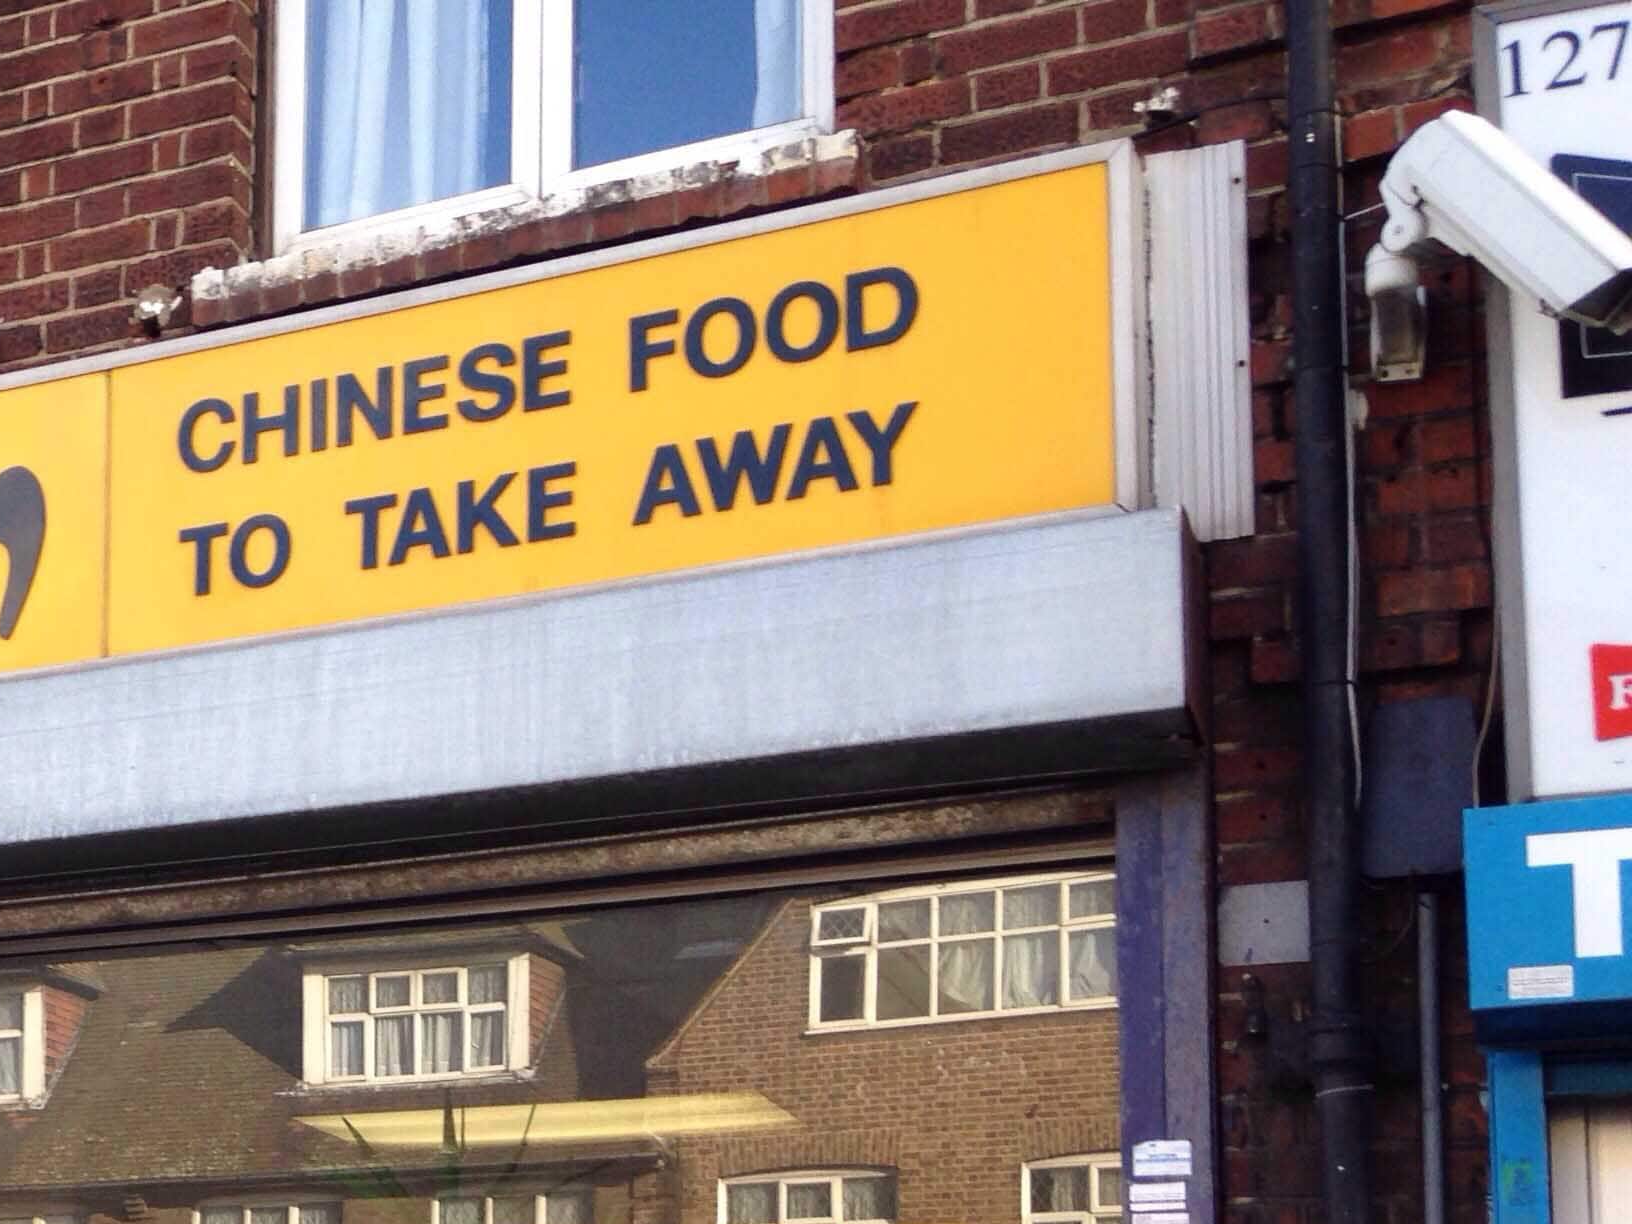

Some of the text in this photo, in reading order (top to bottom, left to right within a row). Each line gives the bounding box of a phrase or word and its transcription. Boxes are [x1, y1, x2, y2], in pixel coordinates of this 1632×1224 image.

[1503, 20, 1631, 98] 127
[176, 265, 919, 474] CHINESE FOOD
[178, 400, 920, 597] TO TAKE AWAY
